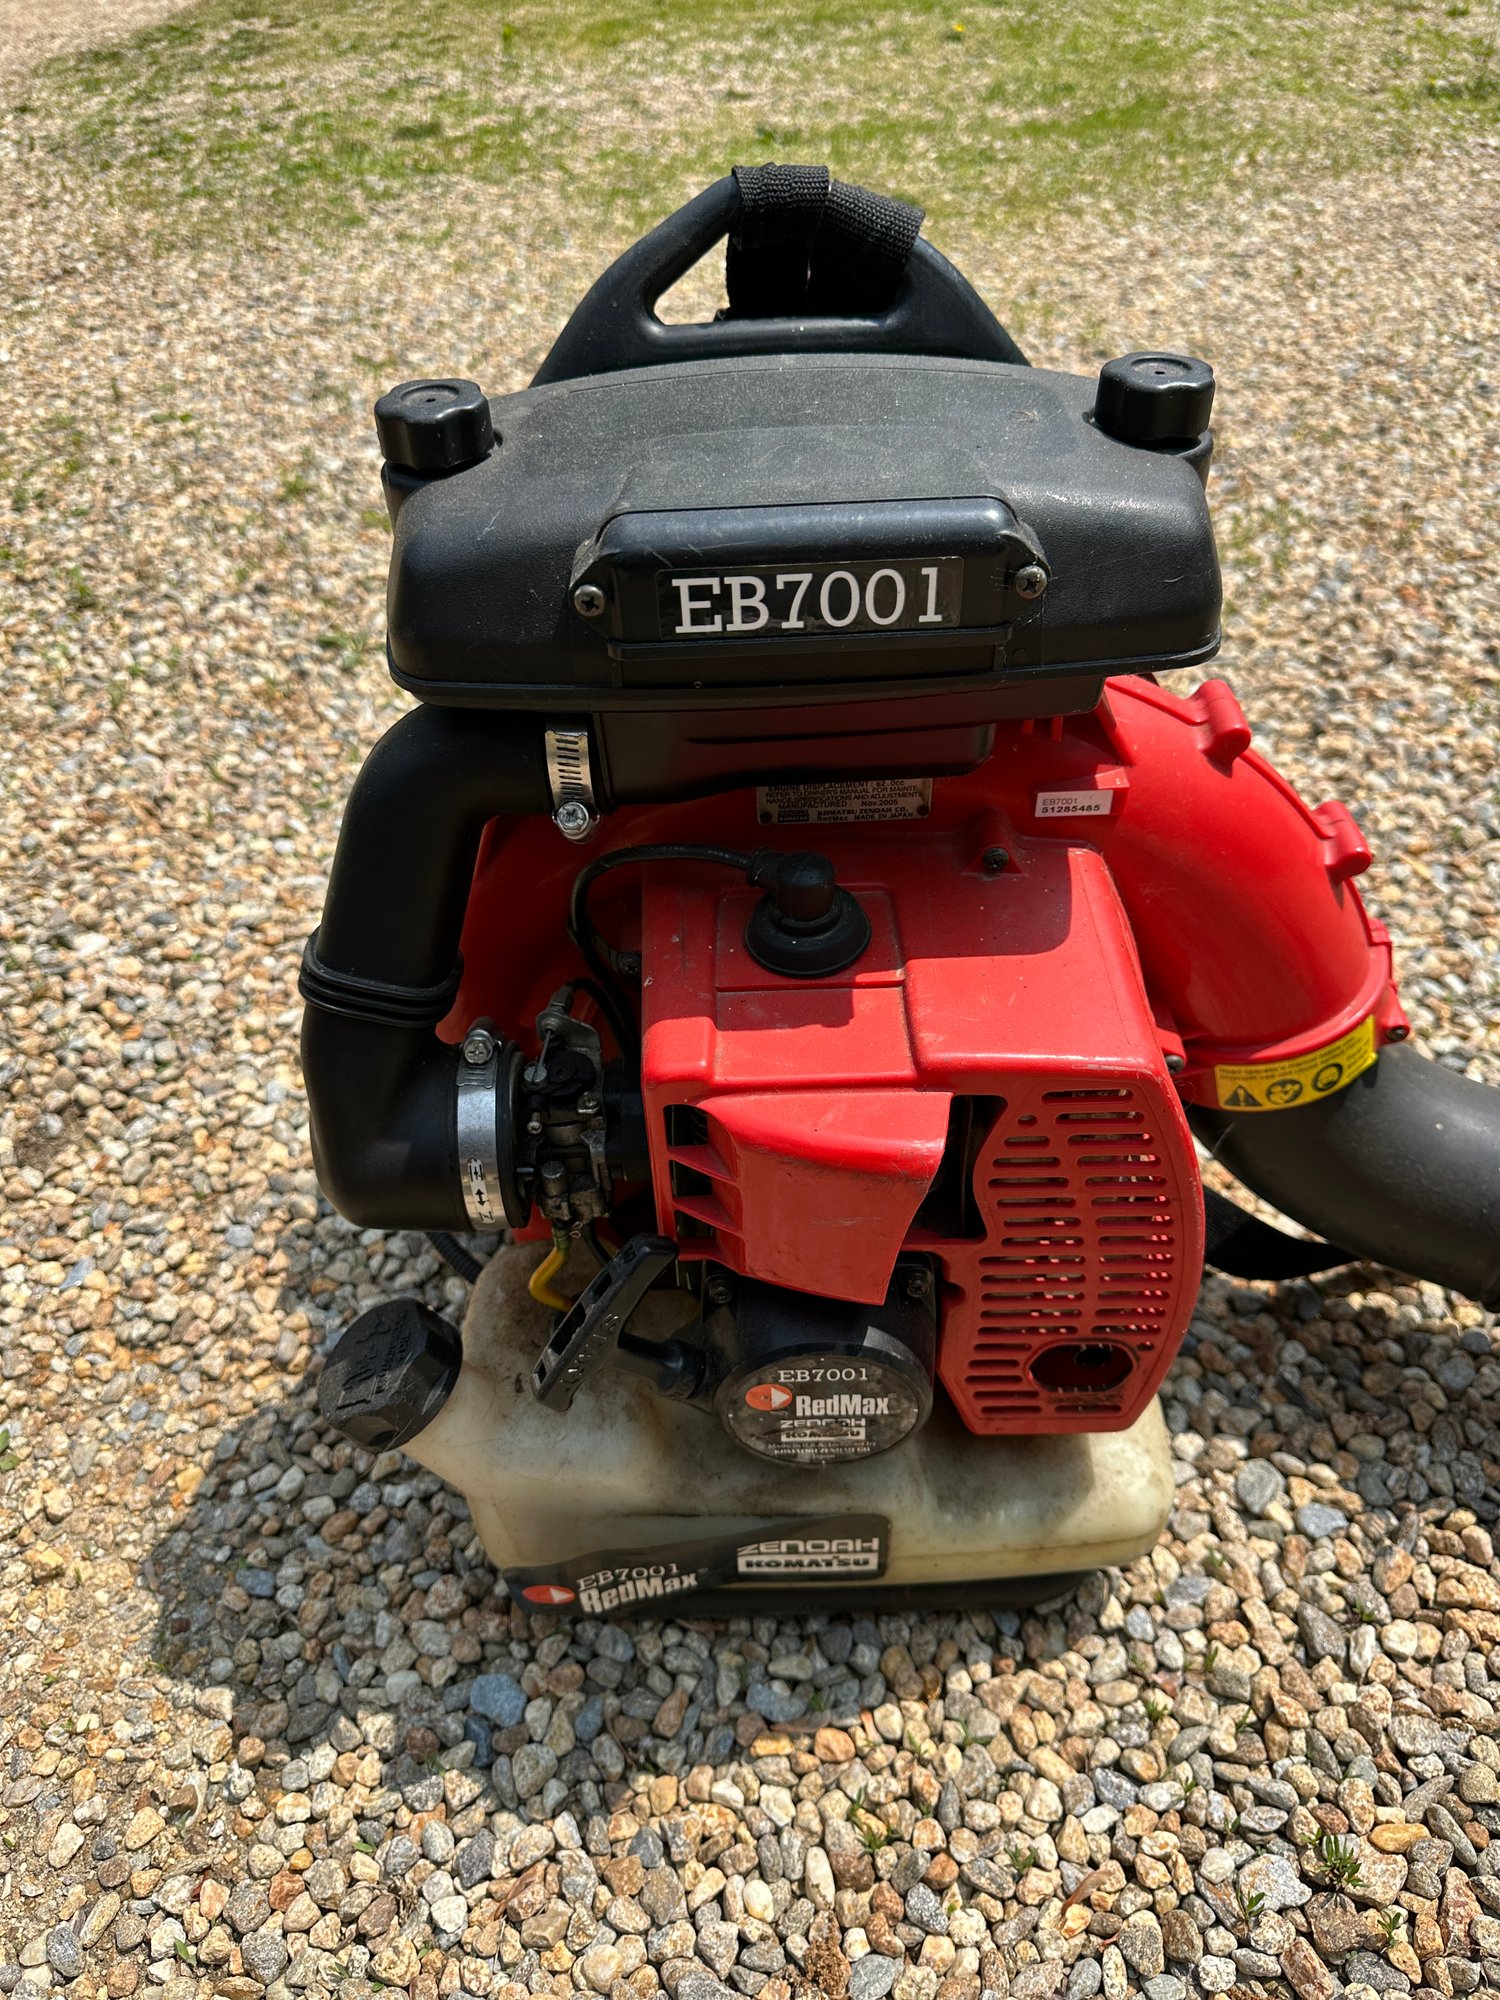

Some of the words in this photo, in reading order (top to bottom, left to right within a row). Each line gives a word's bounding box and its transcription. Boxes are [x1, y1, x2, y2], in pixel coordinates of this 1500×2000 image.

[671, 567, 943, 634] EB7001
[839, 787, 871, 795] MANUAL
[778, 800, 847, 809] MANUFACTURED
[1042, 798, 1078, 806] EB7001
[1042, 804, 1100, 814] 51285485
[777, 1367, 868, 1383] EB7001
[795, 1394, 890, 1417] RedMax
[737, 1537, 880, 1557] ZENOAH
[745, 1557, 870, 1569] KOMATSU
[577, 1562, 679, 1591] EB7001
[579, 1573, 698, 1613] RedMax
